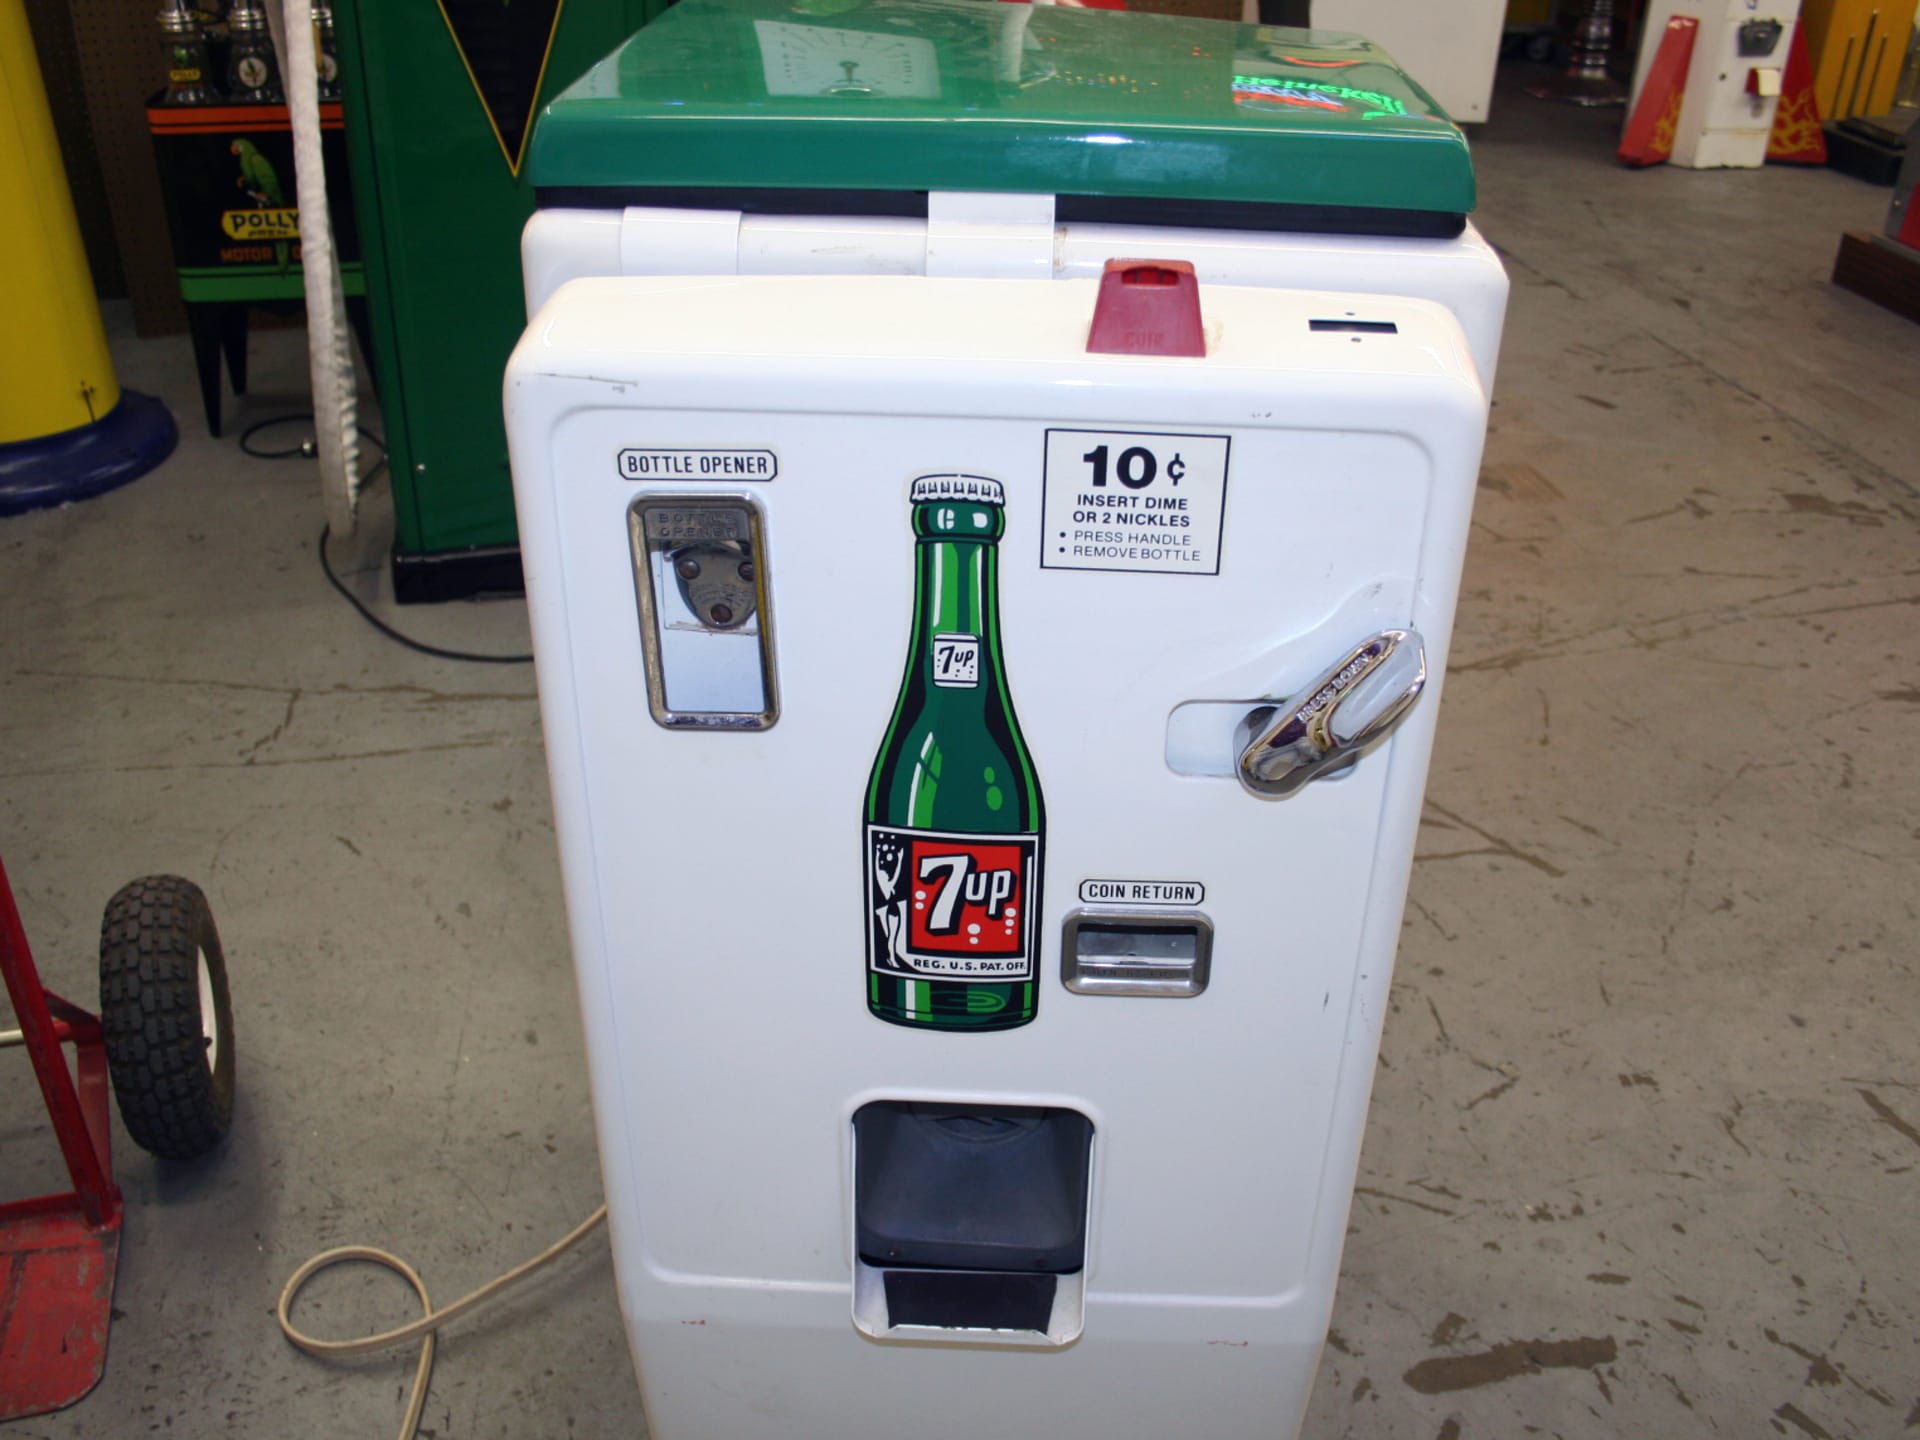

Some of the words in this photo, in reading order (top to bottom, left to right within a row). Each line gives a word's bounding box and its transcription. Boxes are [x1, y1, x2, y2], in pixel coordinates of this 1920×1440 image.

[230, 212, 300, 233] POLLY
[627, 455, 693, 474] BOTTLE
[700, 456, 768, 474] OPENER
[1077, 493, 1139, 508] INSERT
[1145, 496, 1188, 511] DIME
[658, 513, 735, 525] BOTTLE
[1072, 510, 1097, 524] OR
[1102, 511, 1112, 525] 2
[1116, 512, 1190, 528] NICKLES
[1074, 530, 1123, 544] PRESS
[1128, 532, 1191, 546] HANDLE
[1073, 545, 1137, 559] REMOVE
[1141, 548, 1200, 562] BOTTLE
[1297, 686, 1334, 722] PRESS
[1331, 651, 1370, 690] DOWN
[1088, 883, 1126, 898] COIN
[1132, 884, 1195, 900] RETURN
[913, 958, 946, 970] REG.
[950, 961, 977, 971] U.S.
[980, 962, 1005, 972] PAT.
